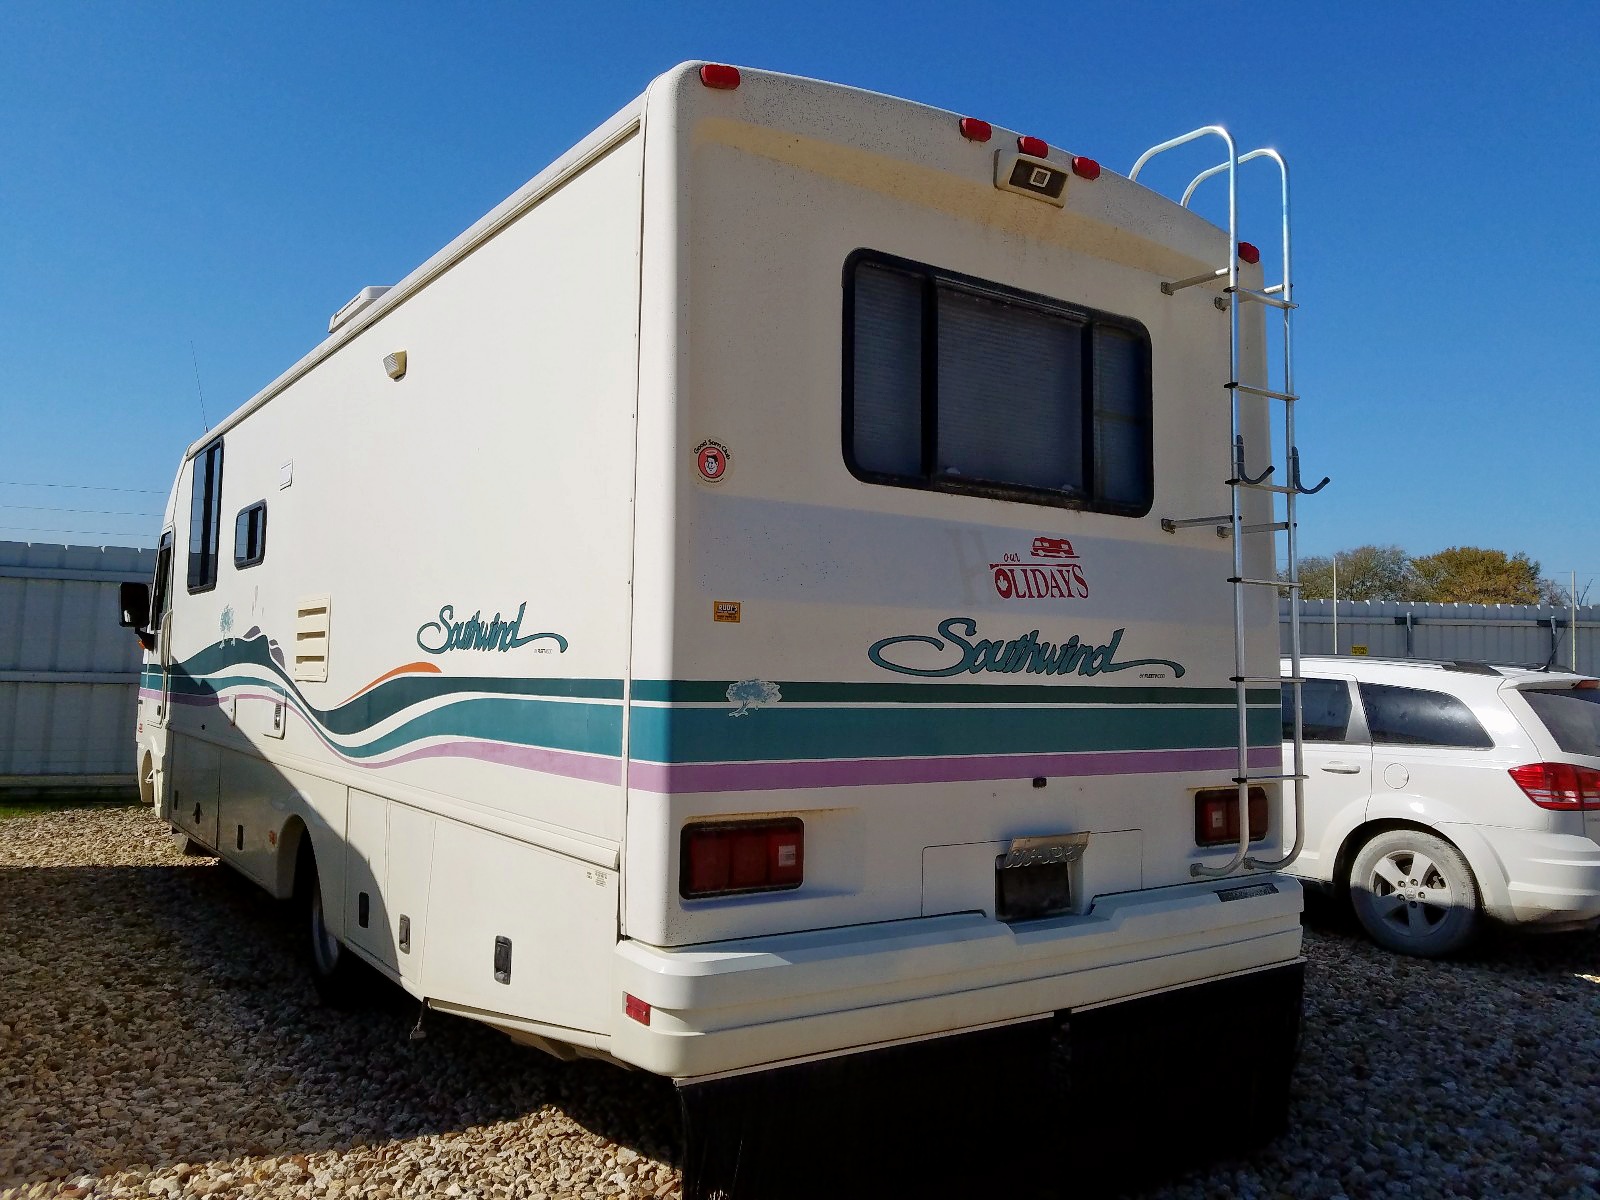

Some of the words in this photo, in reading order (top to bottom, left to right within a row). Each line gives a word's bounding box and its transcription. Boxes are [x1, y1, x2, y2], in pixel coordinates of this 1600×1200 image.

[693, 440, 708, 454] Good
[708, 439, 721, 448] Sam
[721, 446, 731, 460] Club
[1003, 553, 1021, 562] our
[416, 601, 569, 654] Southwind
[868, 617, 1185, 677] Southwind
